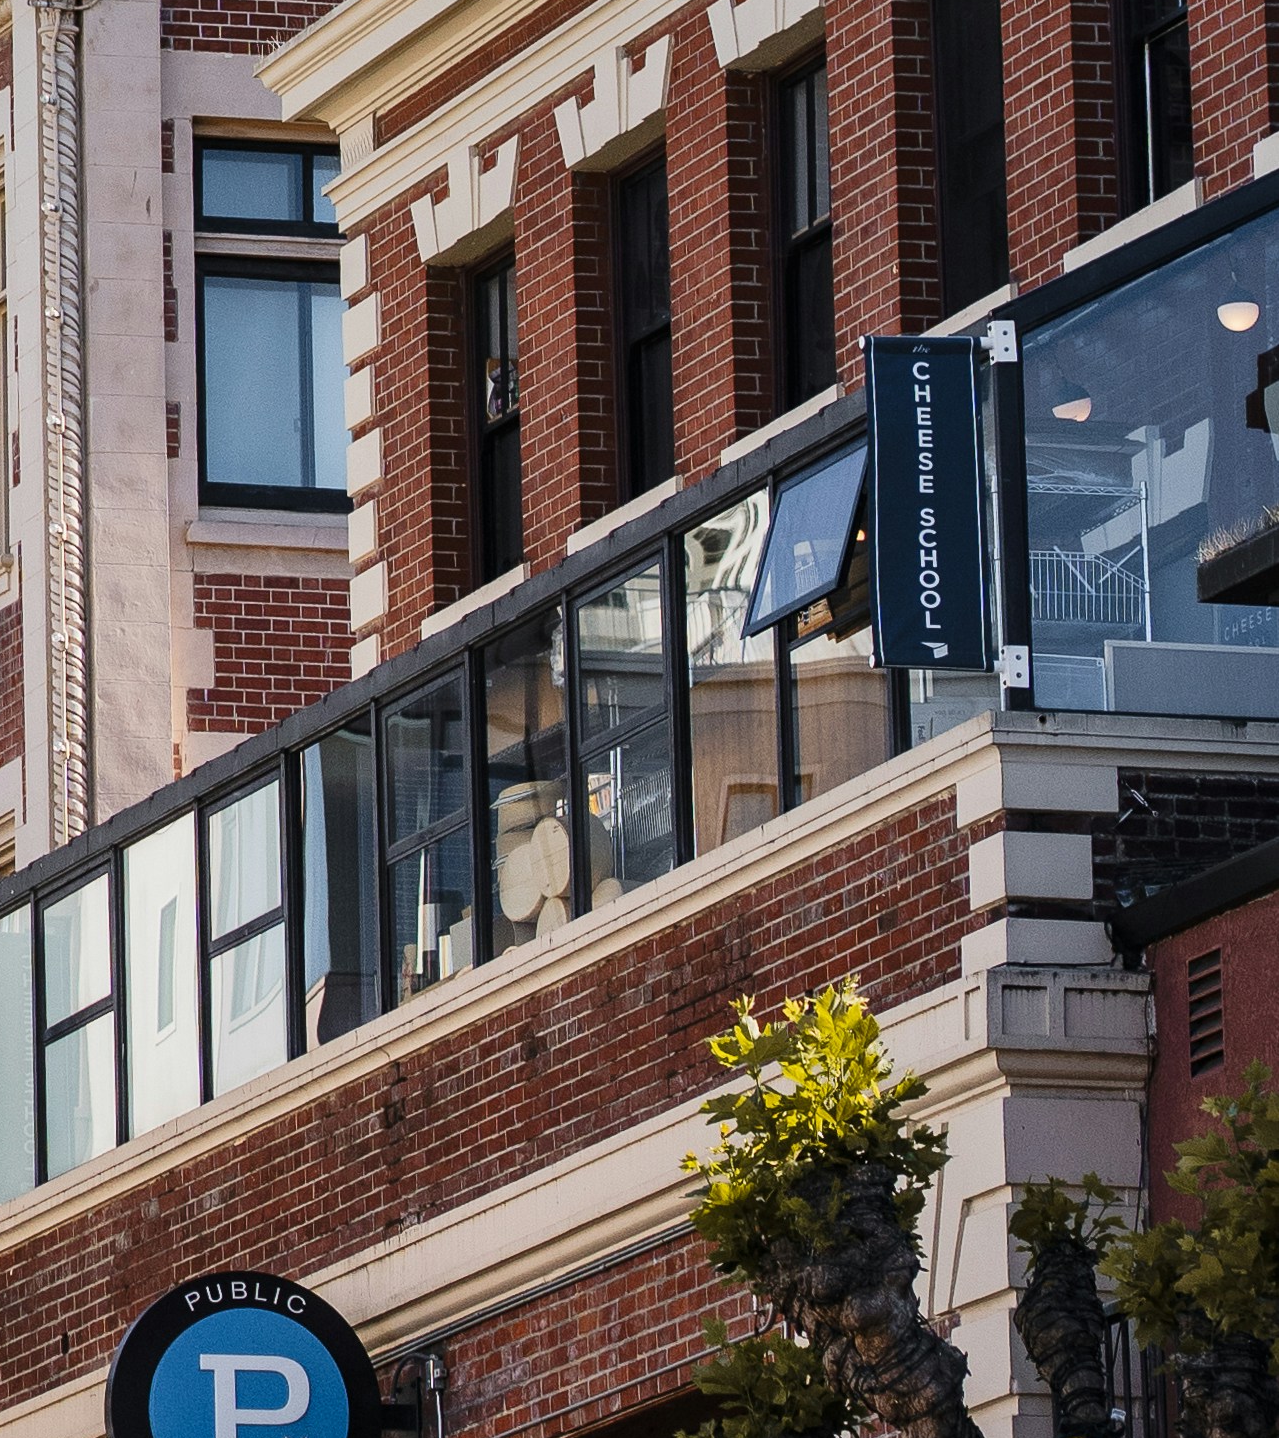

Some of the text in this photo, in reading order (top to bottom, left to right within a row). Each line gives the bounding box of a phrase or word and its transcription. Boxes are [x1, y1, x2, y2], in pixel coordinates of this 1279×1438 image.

[912, 361, 942, 629] CHEESE SCHOOL
[184, 1281, 307, 1314] PUBLIC
